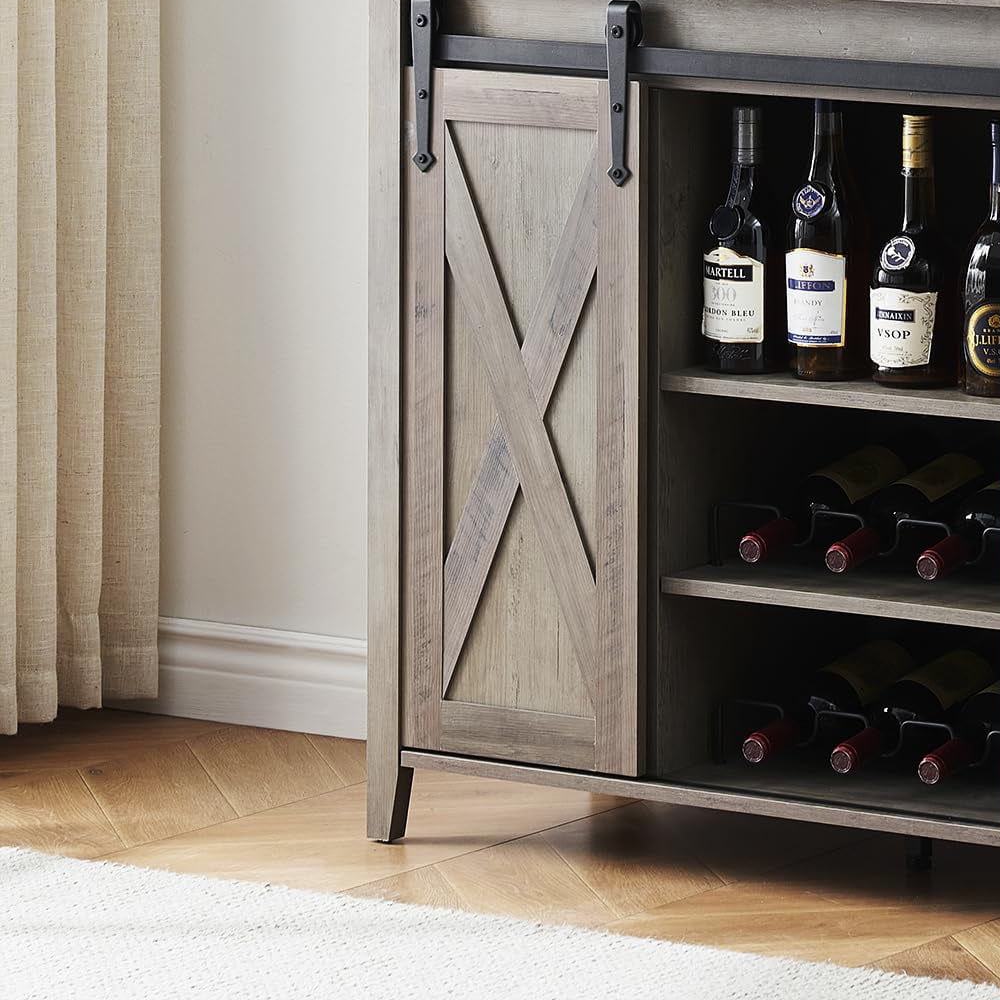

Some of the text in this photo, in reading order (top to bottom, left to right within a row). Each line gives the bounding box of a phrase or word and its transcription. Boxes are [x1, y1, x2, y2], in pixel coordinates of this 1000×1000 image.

[705, 265, 746, 279] MARTELL
[711, 286, 737, 303] 300
[731, 309, 755, 317] BLEU
[877, 327, 911, 340] VSOP
